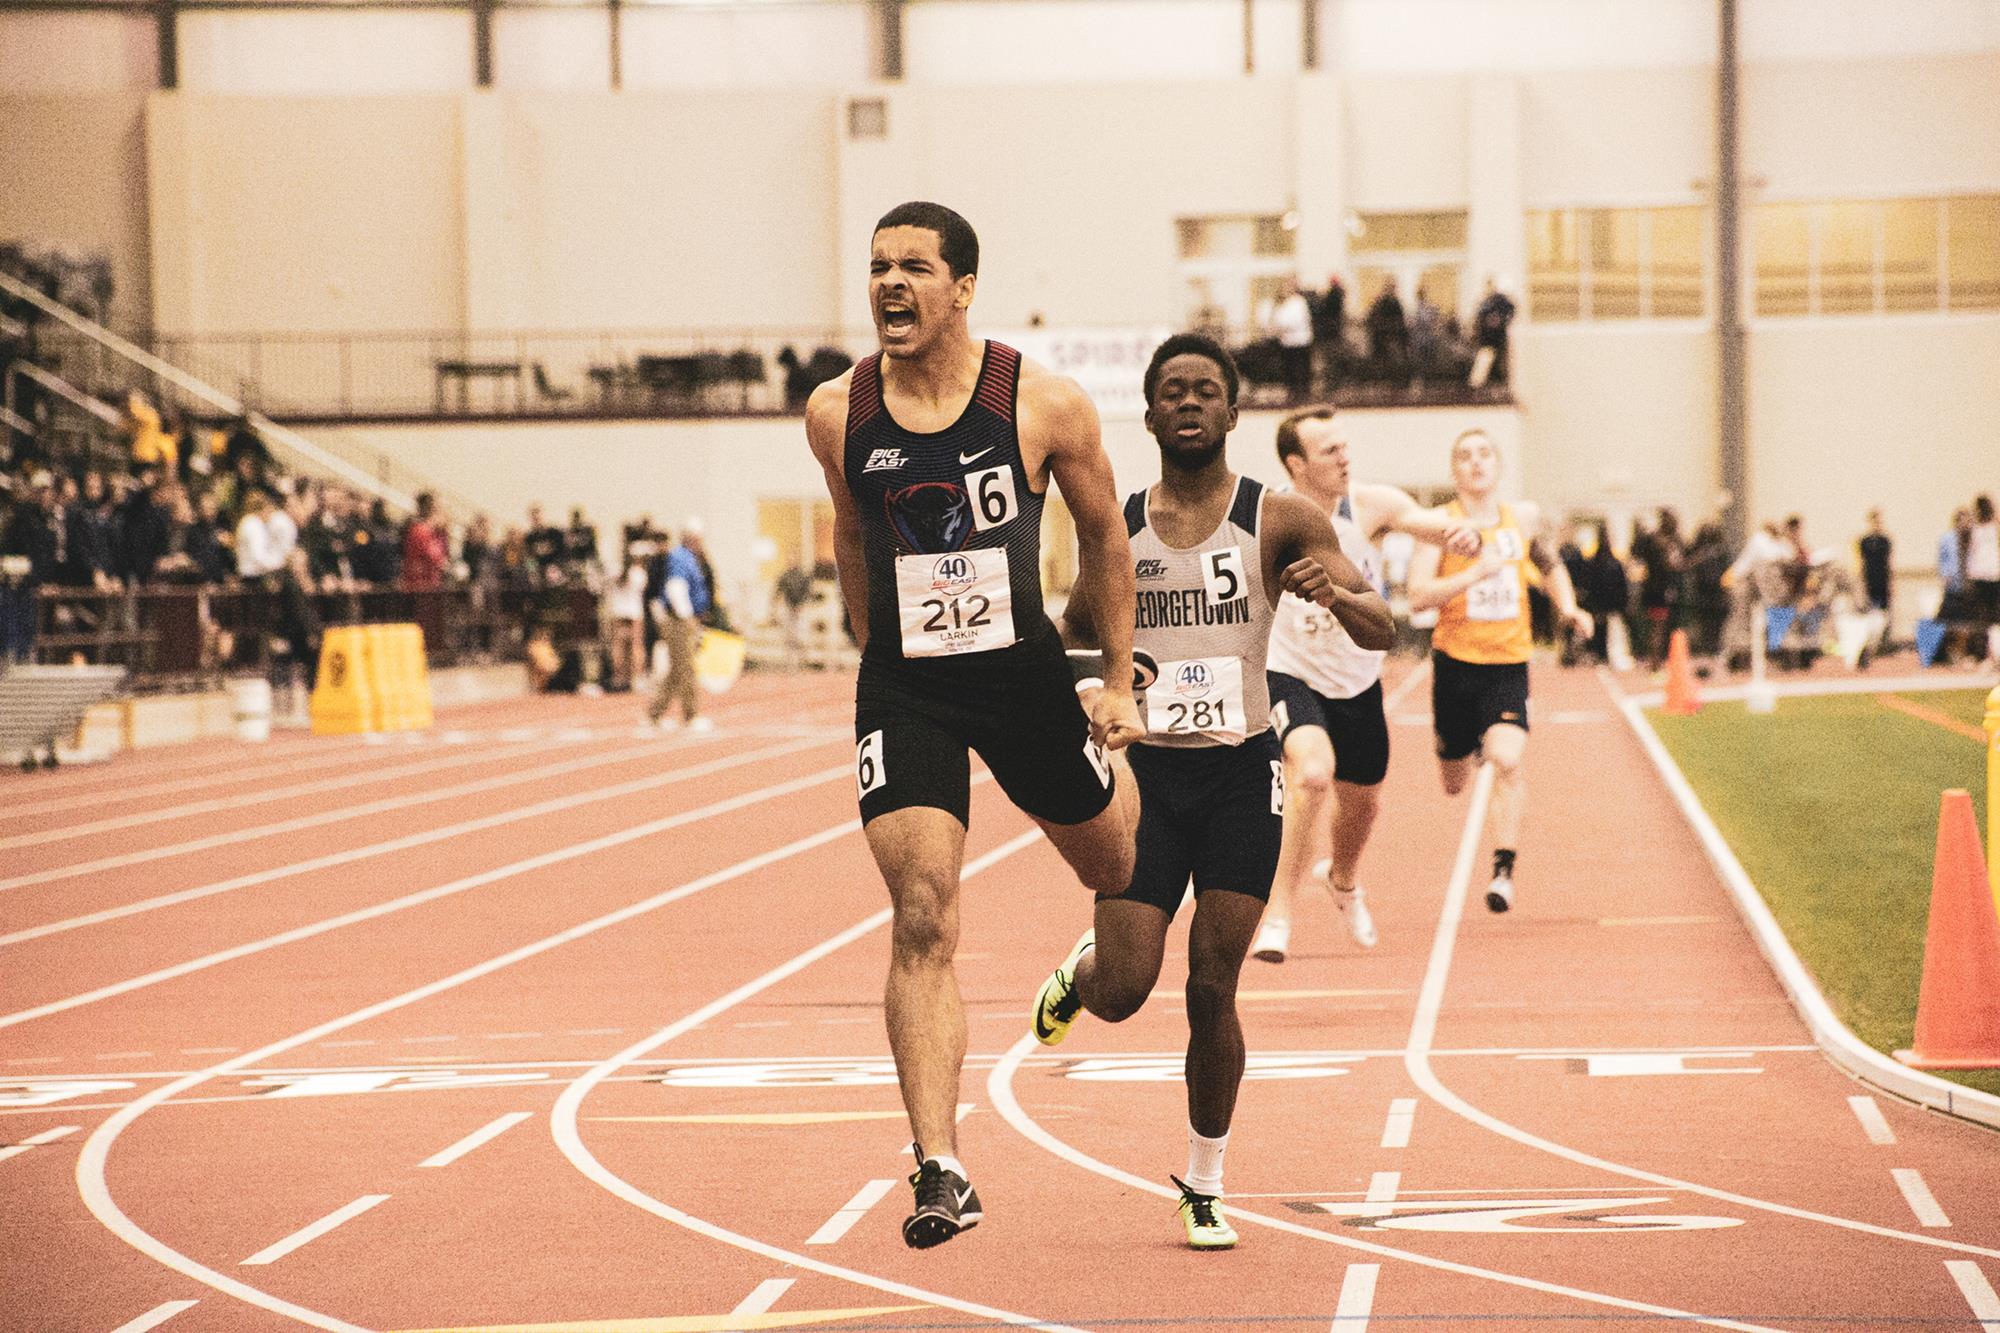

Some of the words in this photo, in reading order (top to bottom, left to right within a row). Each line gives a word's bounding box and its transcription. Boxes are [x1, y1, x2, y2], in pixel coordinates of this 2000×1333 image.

[864, 457, 909, 468] EAST
[870, 448, 901, 459] BIG
[979, 472, 1007, 523] 6
[939, 558, 967, 579] 40
[1137, 559, 1161, 568] BIG
[1212, 552, 1238, 600] 5
[932, 579, 951, 588] BIG
[951, 576, 978, 585] EAST
[921, 594, 991, 632] 212
[1134, 588, 1249, 629] EORGETOWN
[940, 630, 978, 641] LARKIN
[1181, 664, 1205, 683] 40
[1167, 698, 1226, 732] 281
[859, 738, 874, 790] 6
[1321, 1197, 1747, 1233] 2
